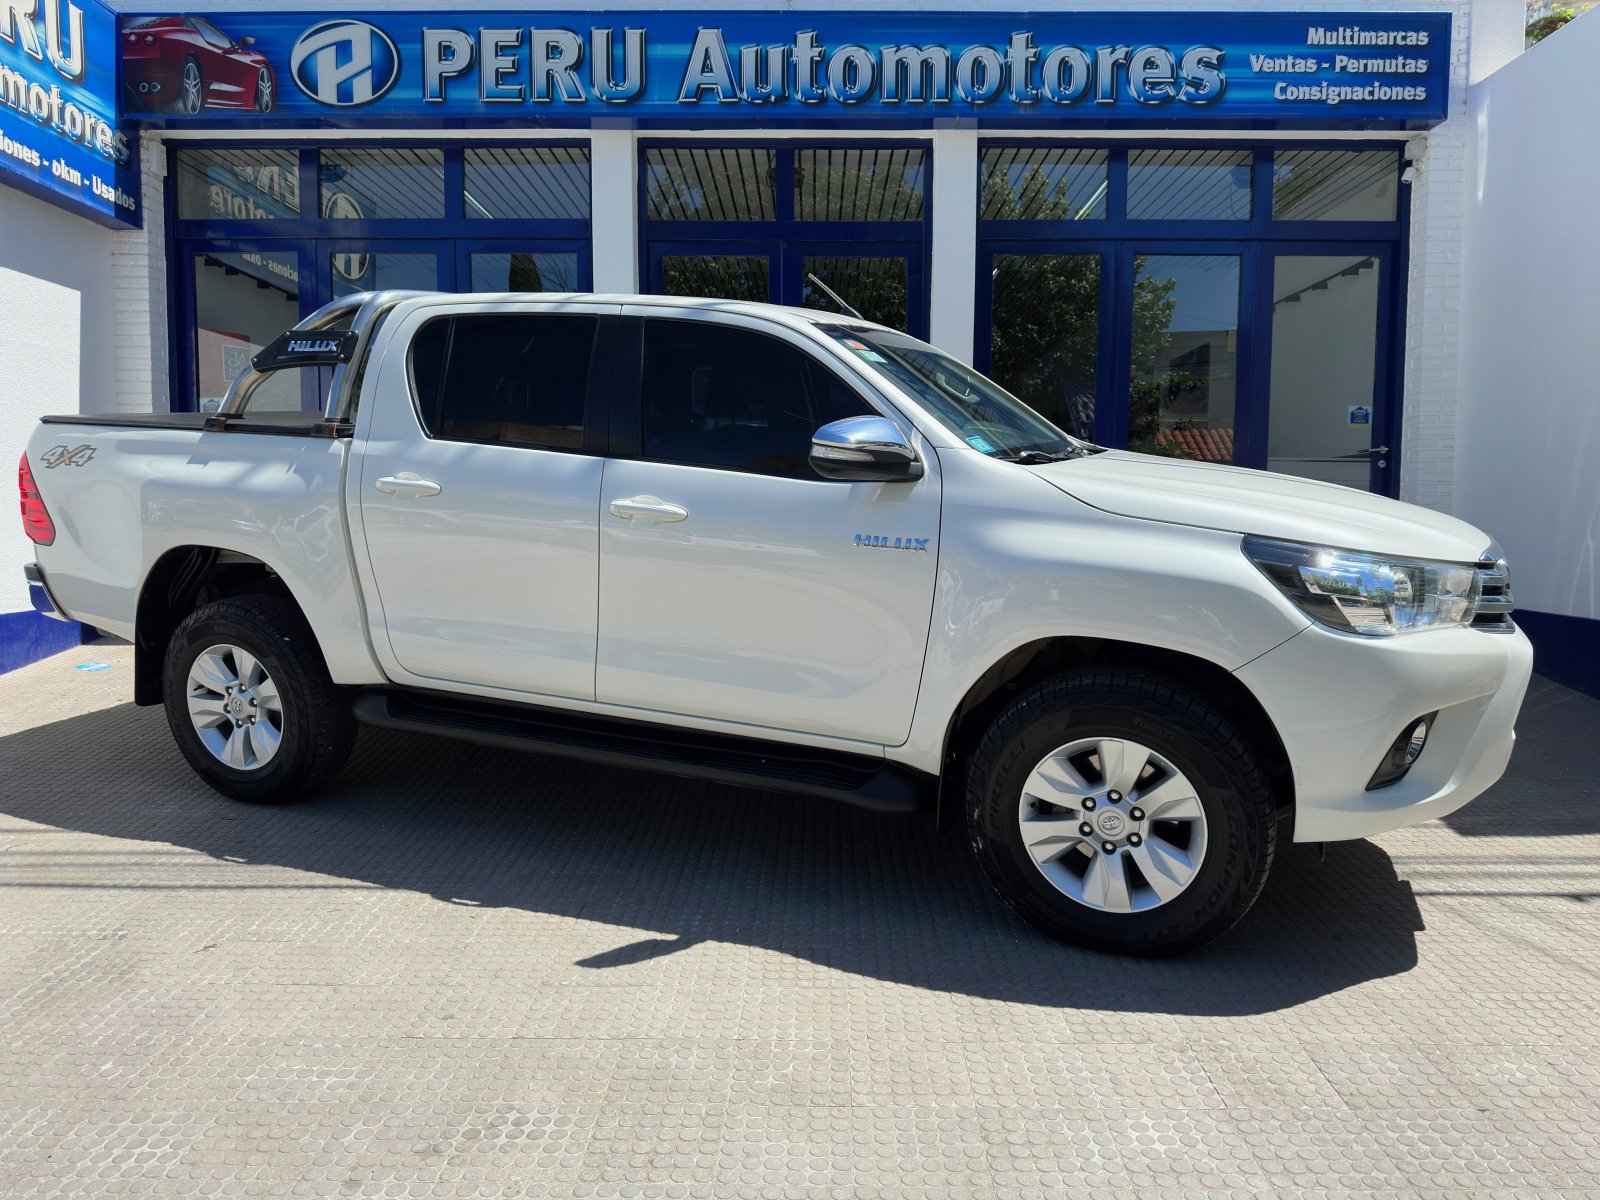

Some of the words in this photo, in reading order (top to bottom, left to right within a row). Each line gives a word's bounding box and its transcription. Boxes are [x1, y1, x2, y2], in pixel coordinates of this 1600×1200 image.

[1306, 26, 1430, 46] Multimarcas
[422, 26, 648, 103] PERU
[677, 27, 1227, 104] Automotores
[1249, 54, 1318, 73] Ventas
[1334, 54, 1429, 73] Permutas
[1273, 80, 1427, 105] Consignaciones
[92, 174, 136, 211] Usados
[287, 340, 339, 352] HILUX
[852, 534, 930, 552] HILUX
